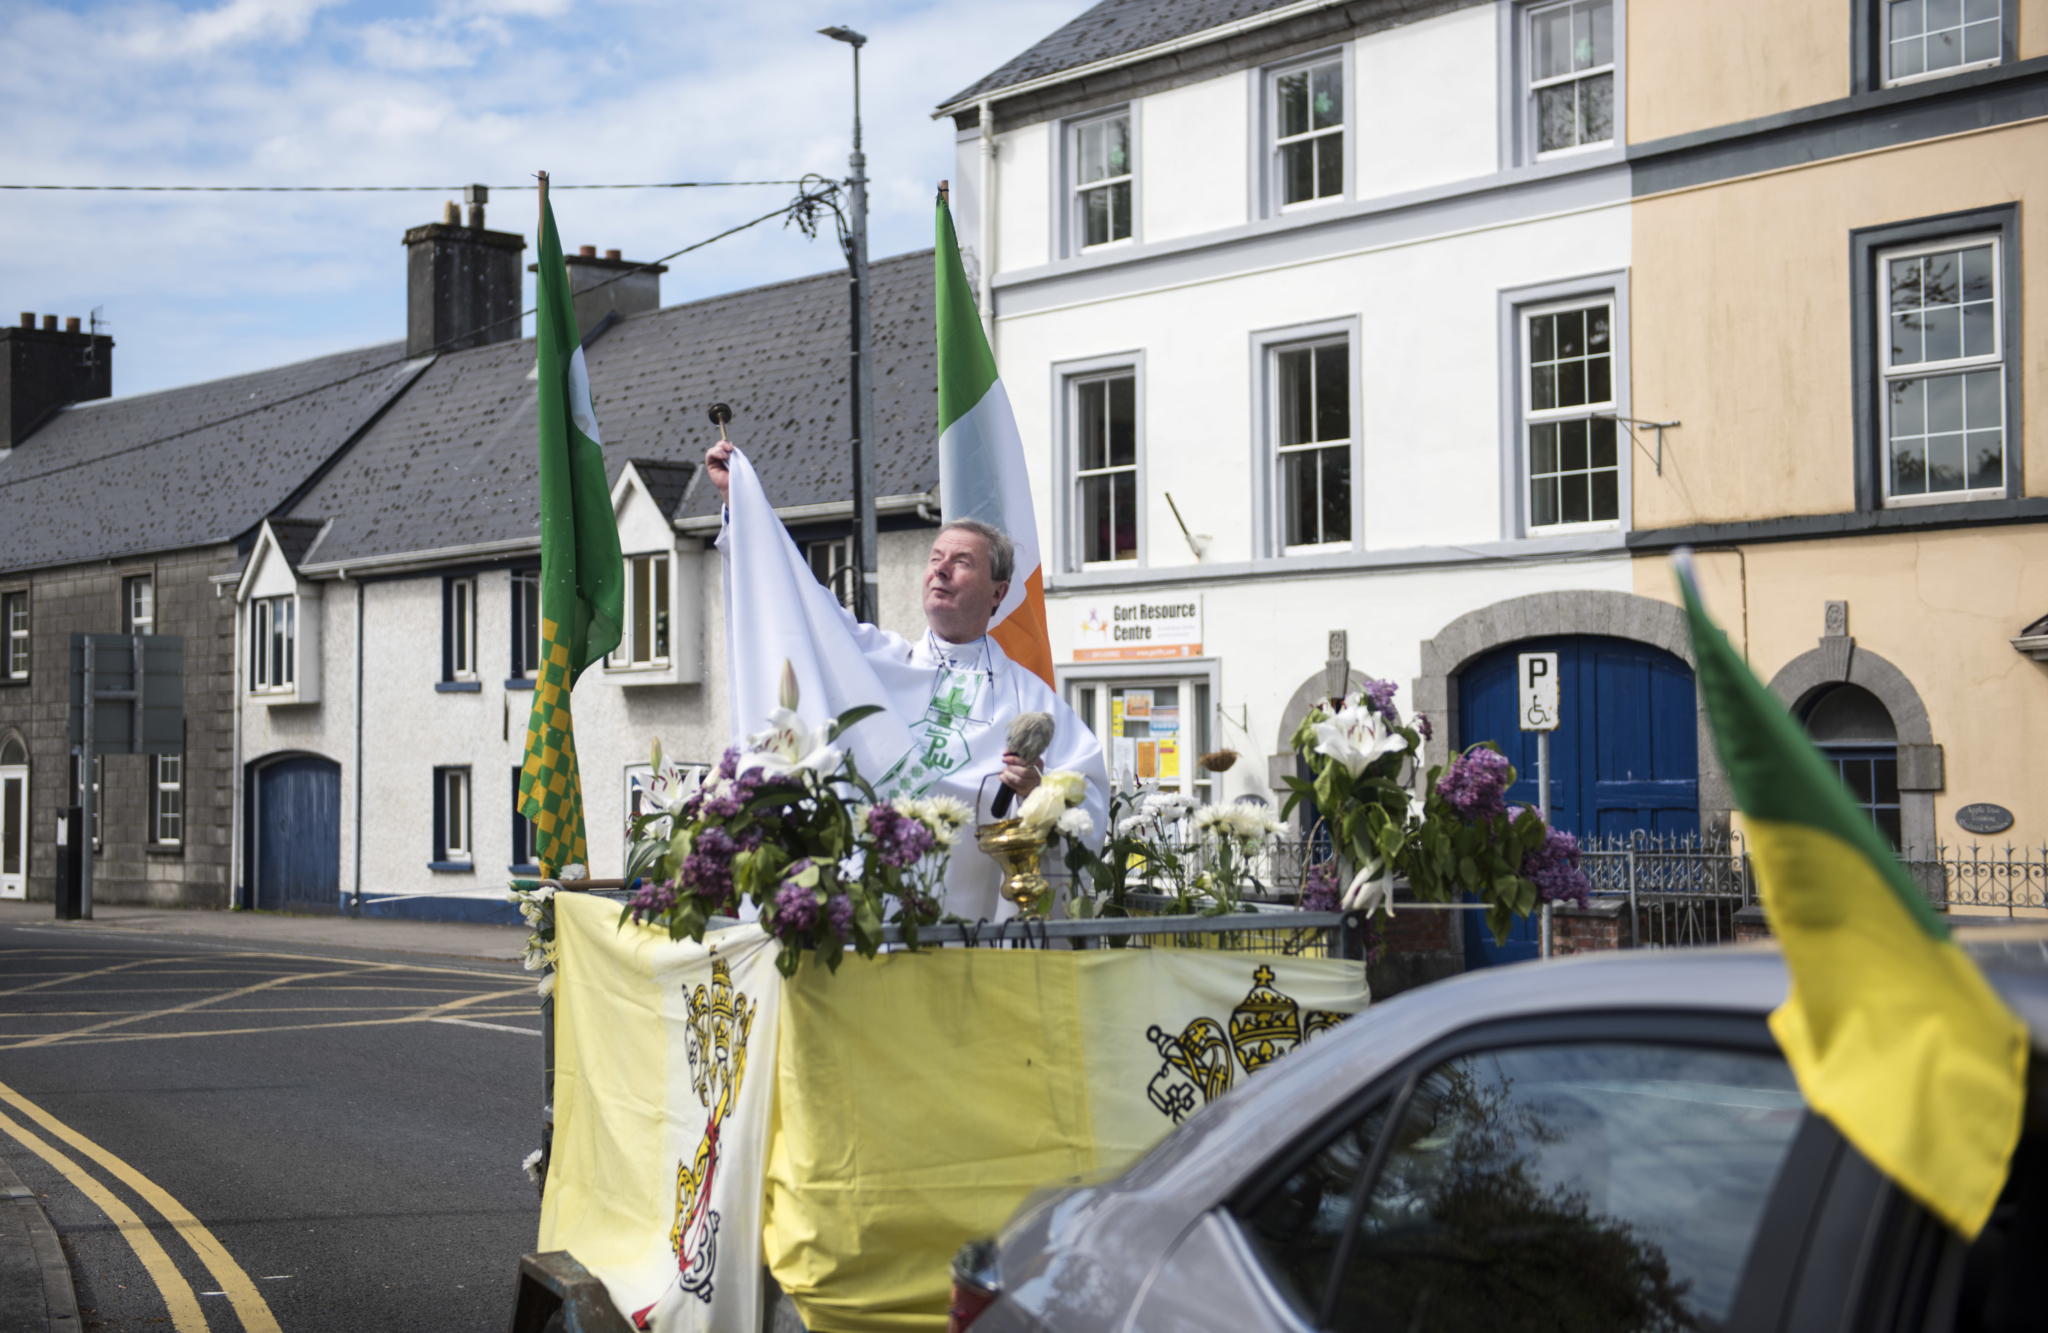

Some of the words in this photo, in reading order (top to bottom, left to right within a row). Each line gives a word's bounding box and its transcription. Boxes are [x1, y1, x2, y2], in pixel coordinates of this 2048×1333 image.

[1114, 605, 1137, 621] Gort
[1140, 603, 1195, 620] Resource
[1114, 624, 1151, 641] Centre
[1529, 658, 1548, 688] P
